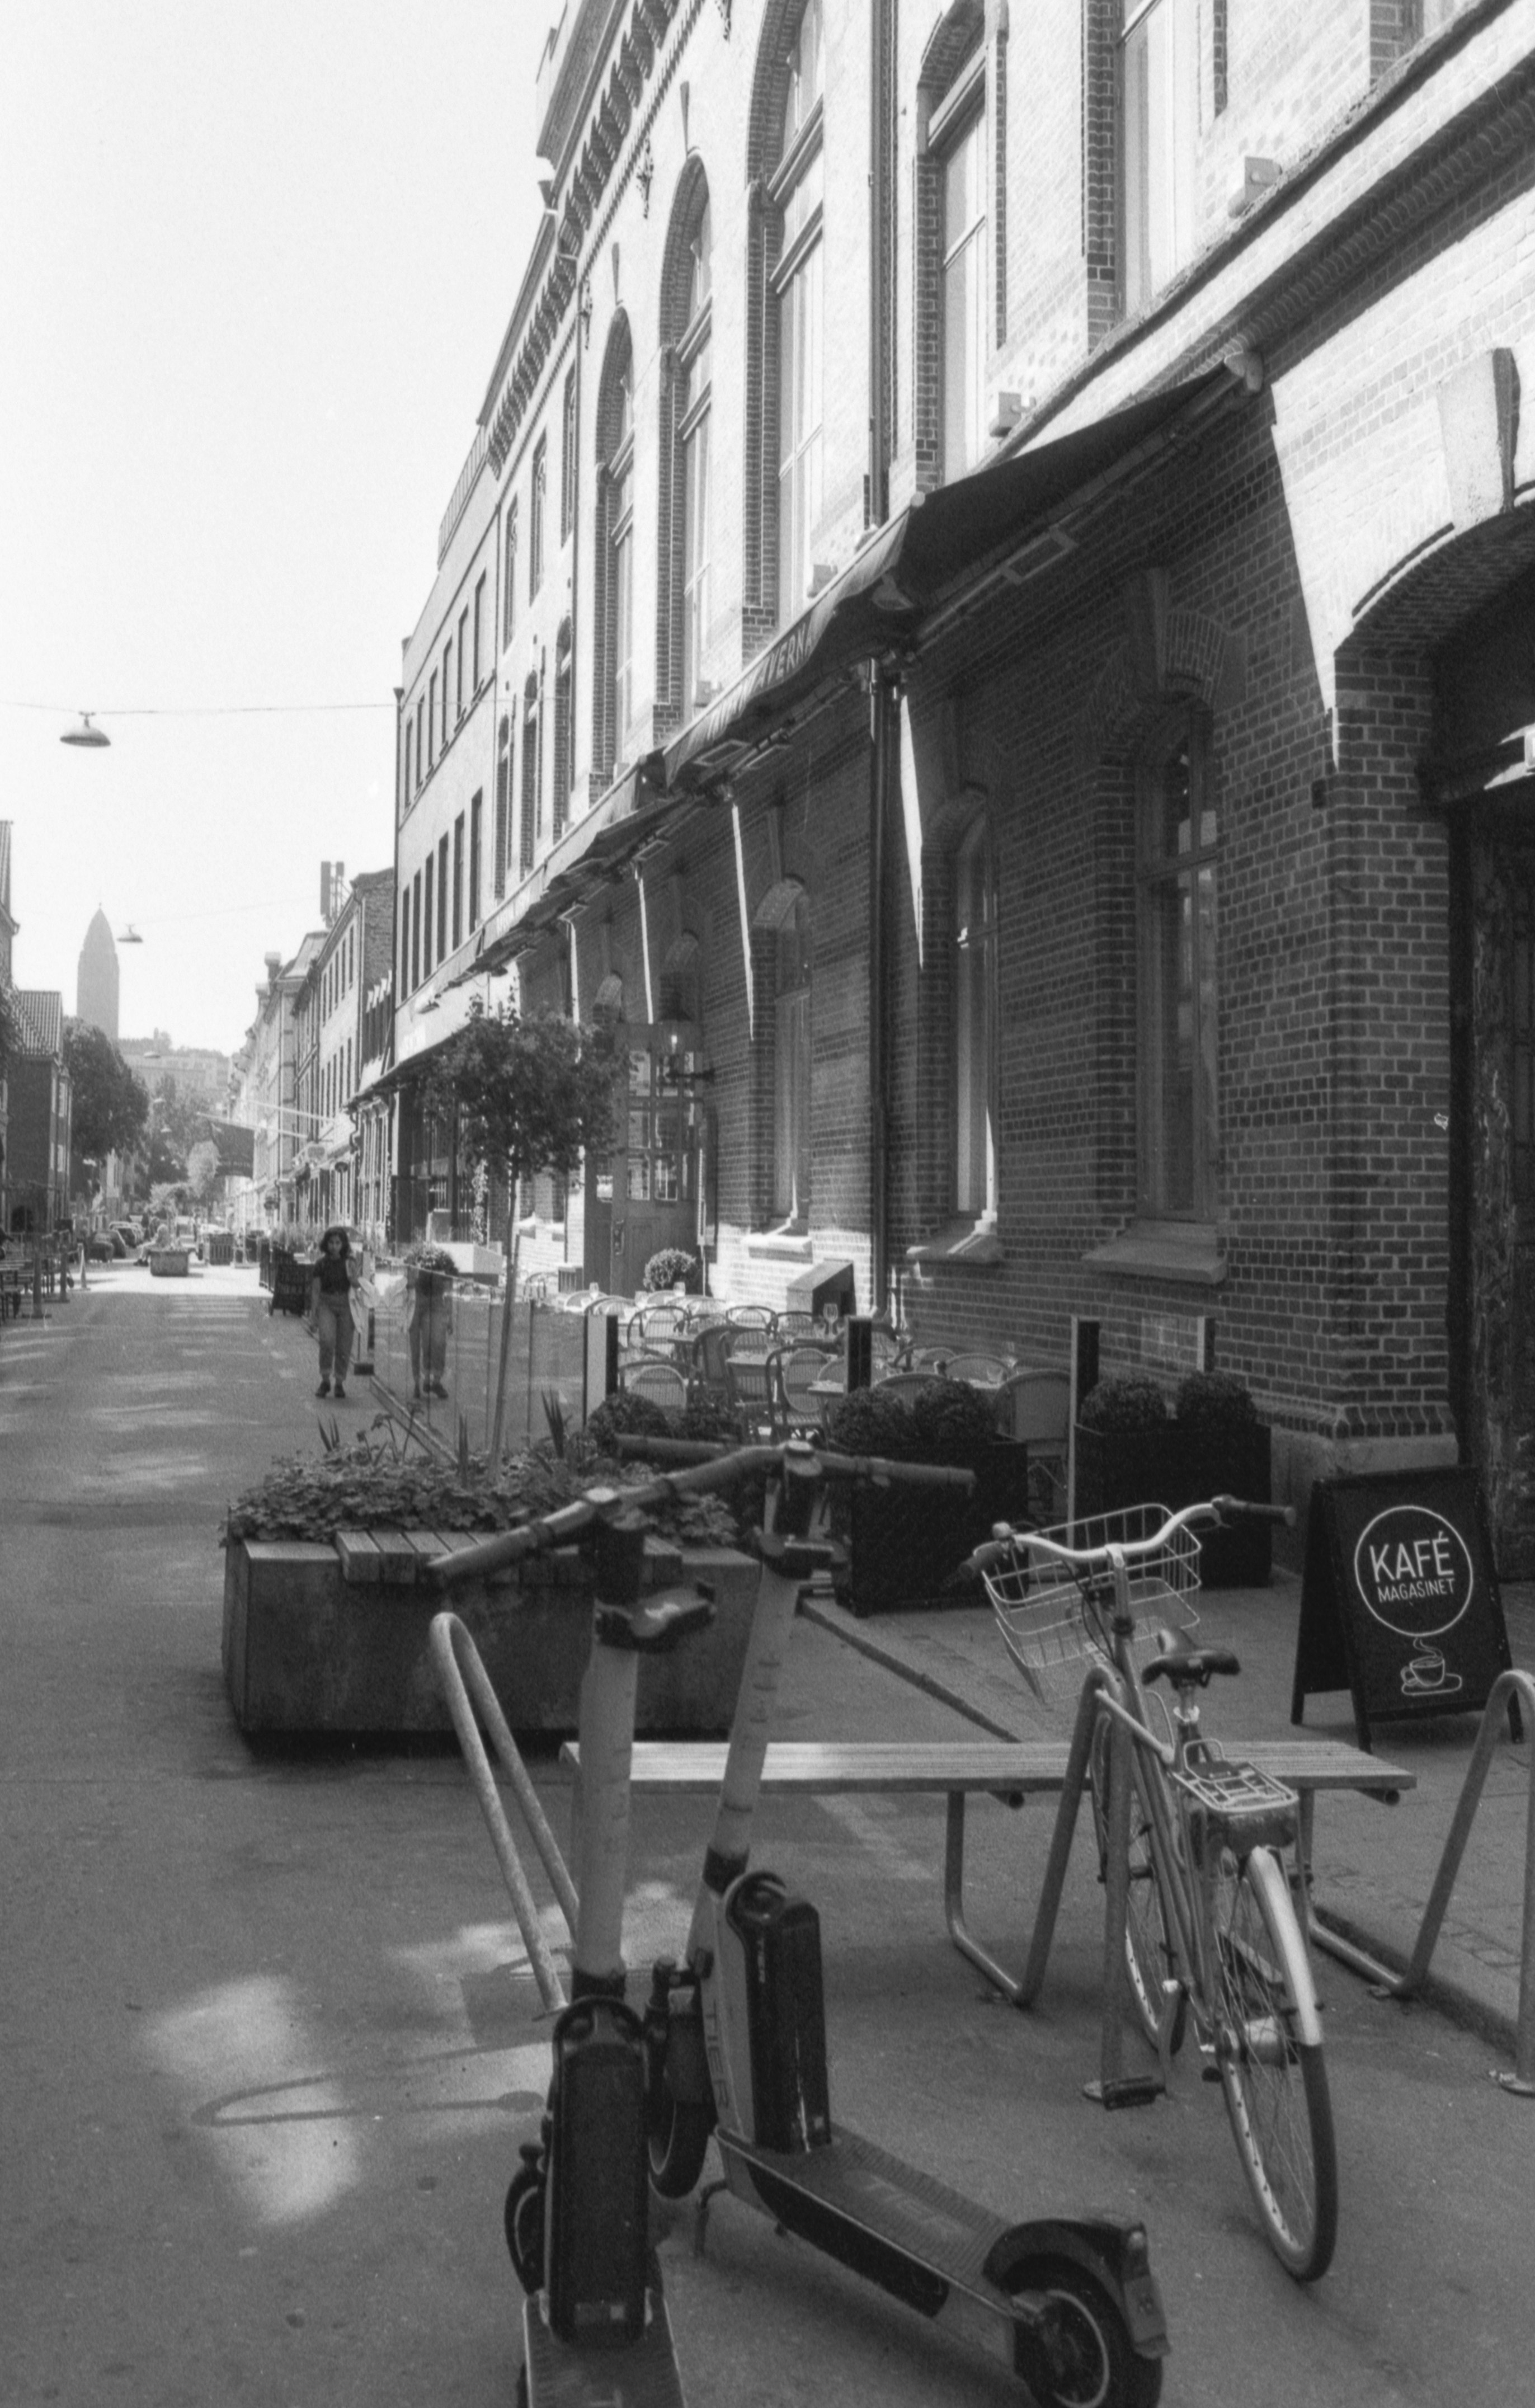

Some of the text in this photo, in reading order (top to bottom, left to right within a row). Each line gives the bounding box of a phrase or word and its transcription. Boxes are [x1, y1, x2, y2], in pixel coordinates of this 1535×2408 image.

[1369, 1531, 1454, 1583] KAFÉ
[1377, 1577, 1456, 1603] MAGASINET
[705, 1998, 729, 2109] TIER
